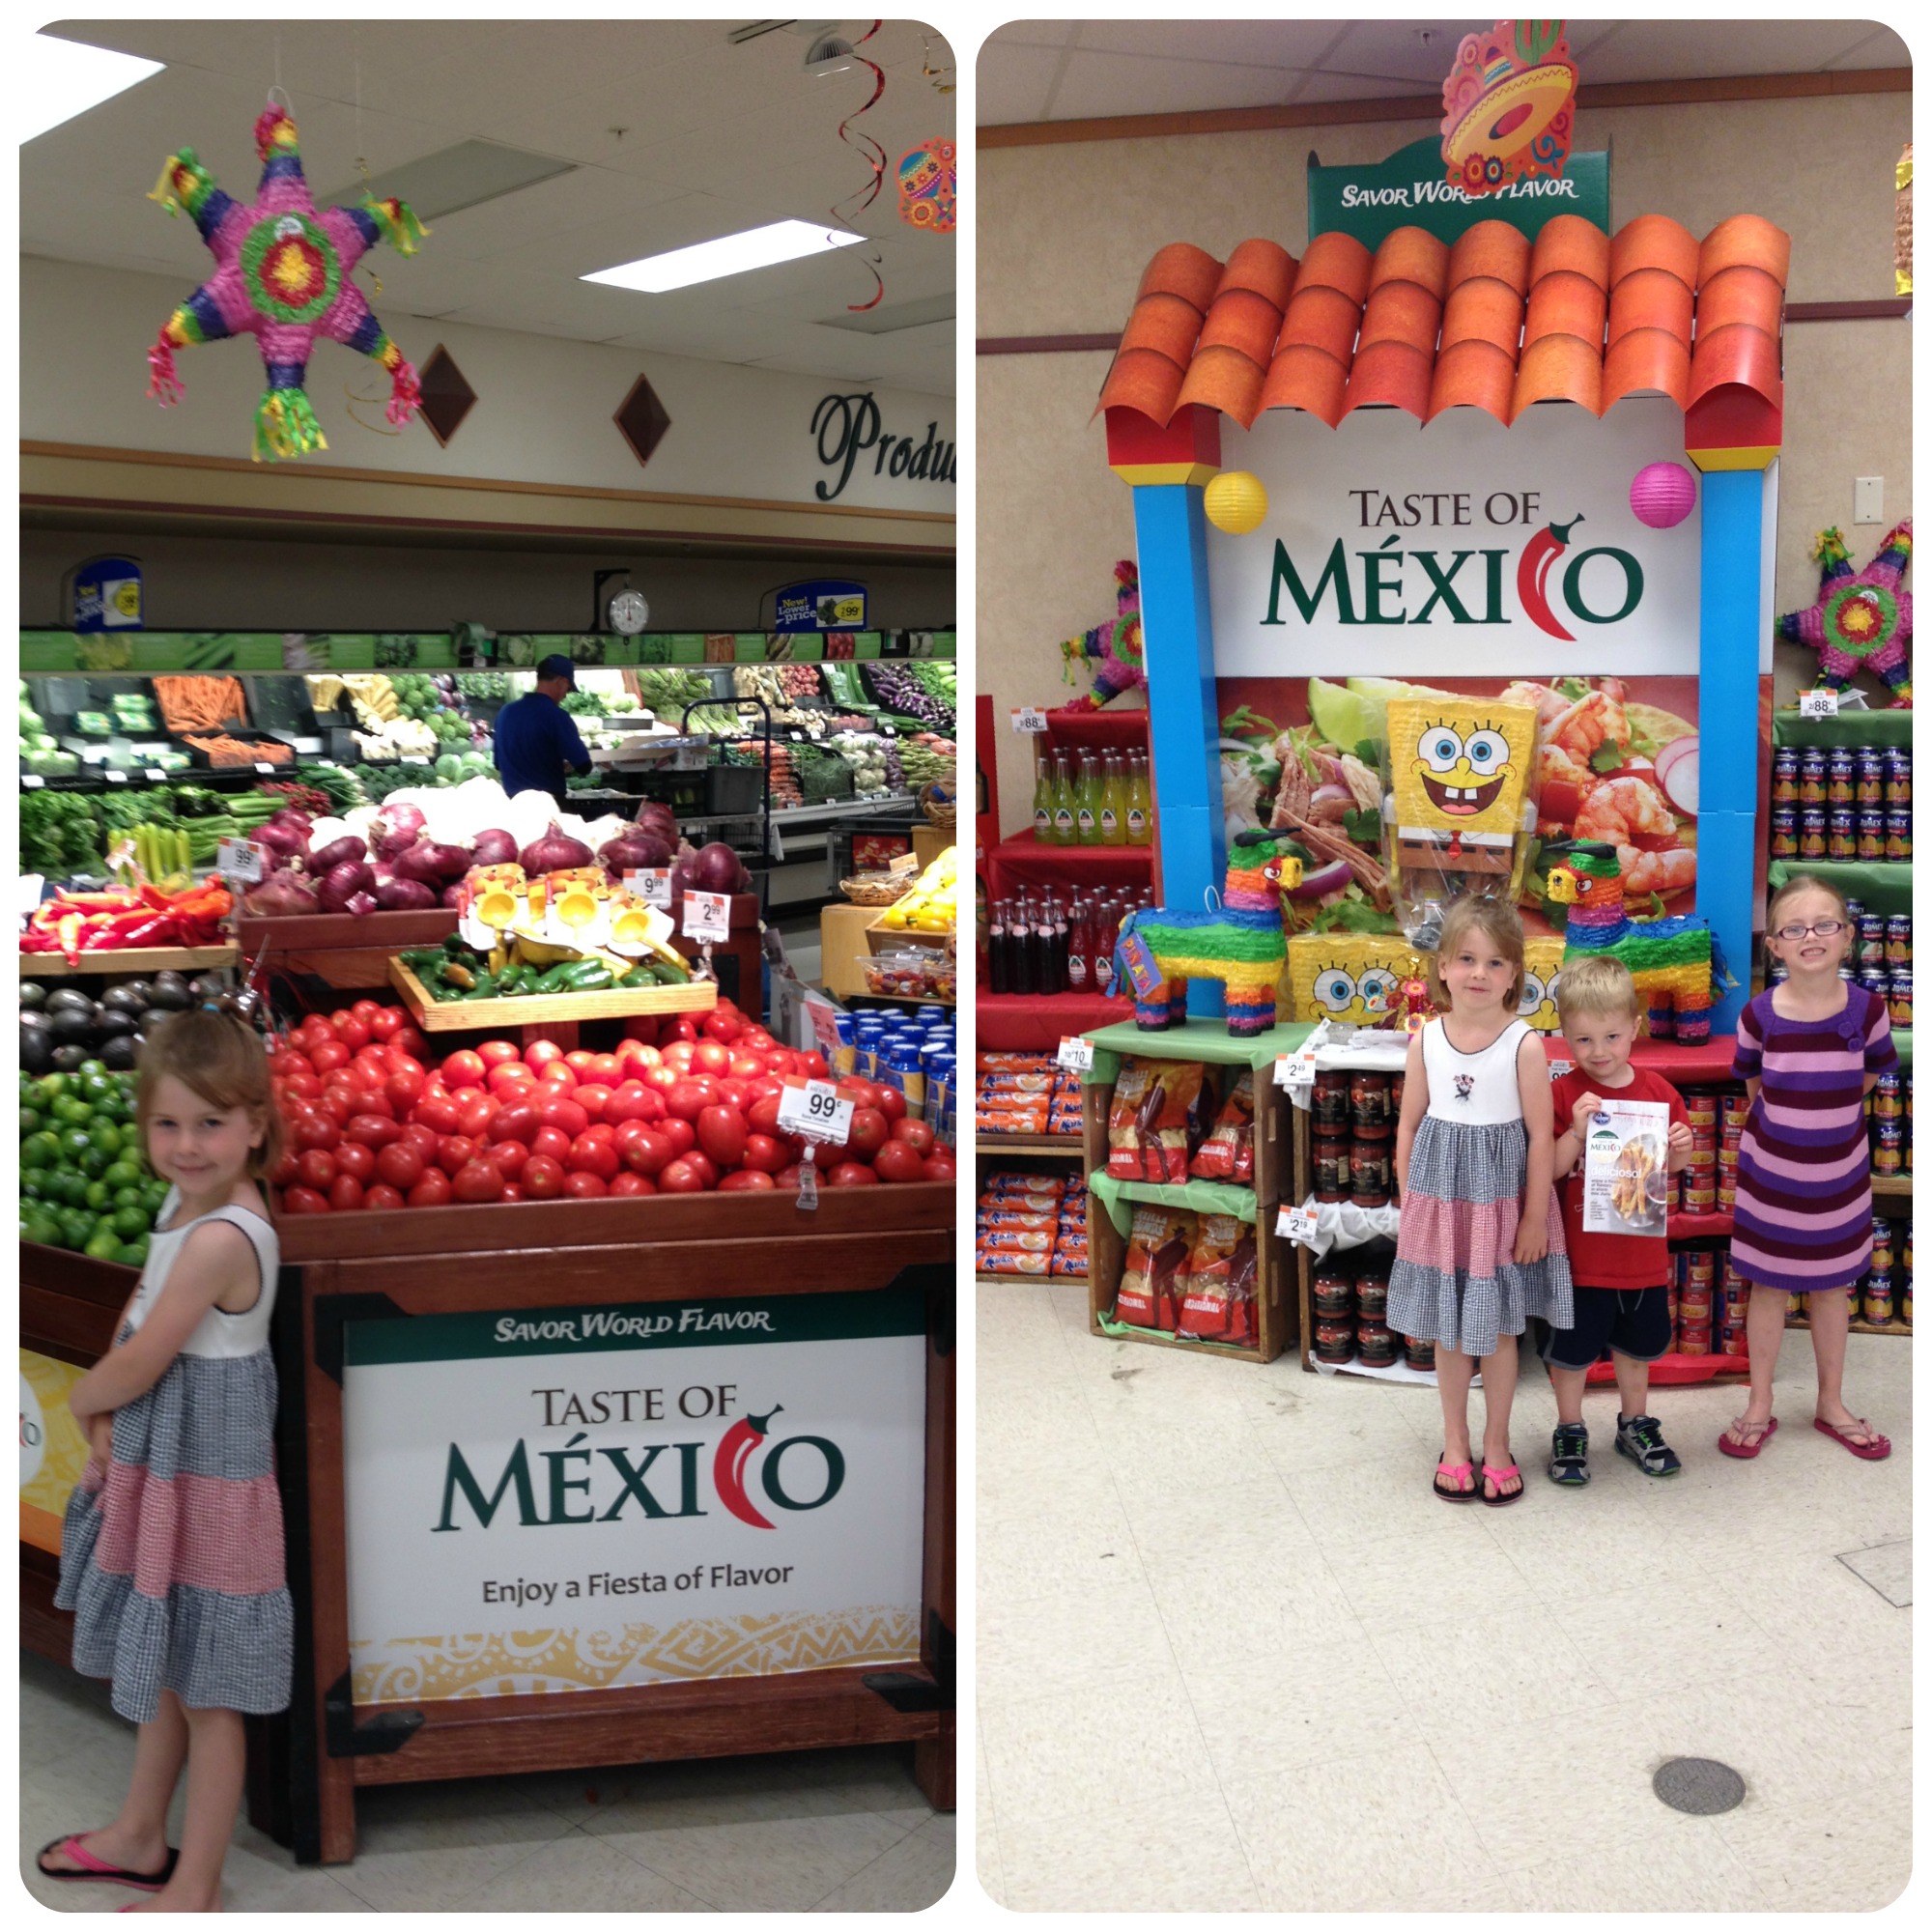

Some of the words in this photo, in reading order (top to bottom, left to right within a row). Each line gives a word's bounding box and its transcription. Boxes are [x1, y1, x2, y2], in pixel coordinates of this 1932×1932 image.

[1341, 185, 1414, 208] SAVOR
[1349, 490, 1472, 527] TASTE
[1484, 492, 1541, 525] OF
[1260, 513, 1644, 641] MÉXICO
[779, 605, 810, 615] Lower
[785, 610, 817, 625] price
[1888, 923, 1910, 932] JUMEX
[494, 1316, 582, 1343] SAVOR
[582, 1312, 674, 1339] WORLD
[678, 1307, 777, 1333] FLAVOR
[531, 1388, 665, 1427] TASTE
[678, 1384, 738, 1419] OF
[431, 1404, 846, 1532] MÉXICO
[483, 1579, 557, 1608] Enjoy
[564, 1582, 582, 1598] a
[587, 1570, 668, 1597] Fiesta
[674, 1566, 704, 1590] of
[710, 1563, 794, 1587] Flavor
